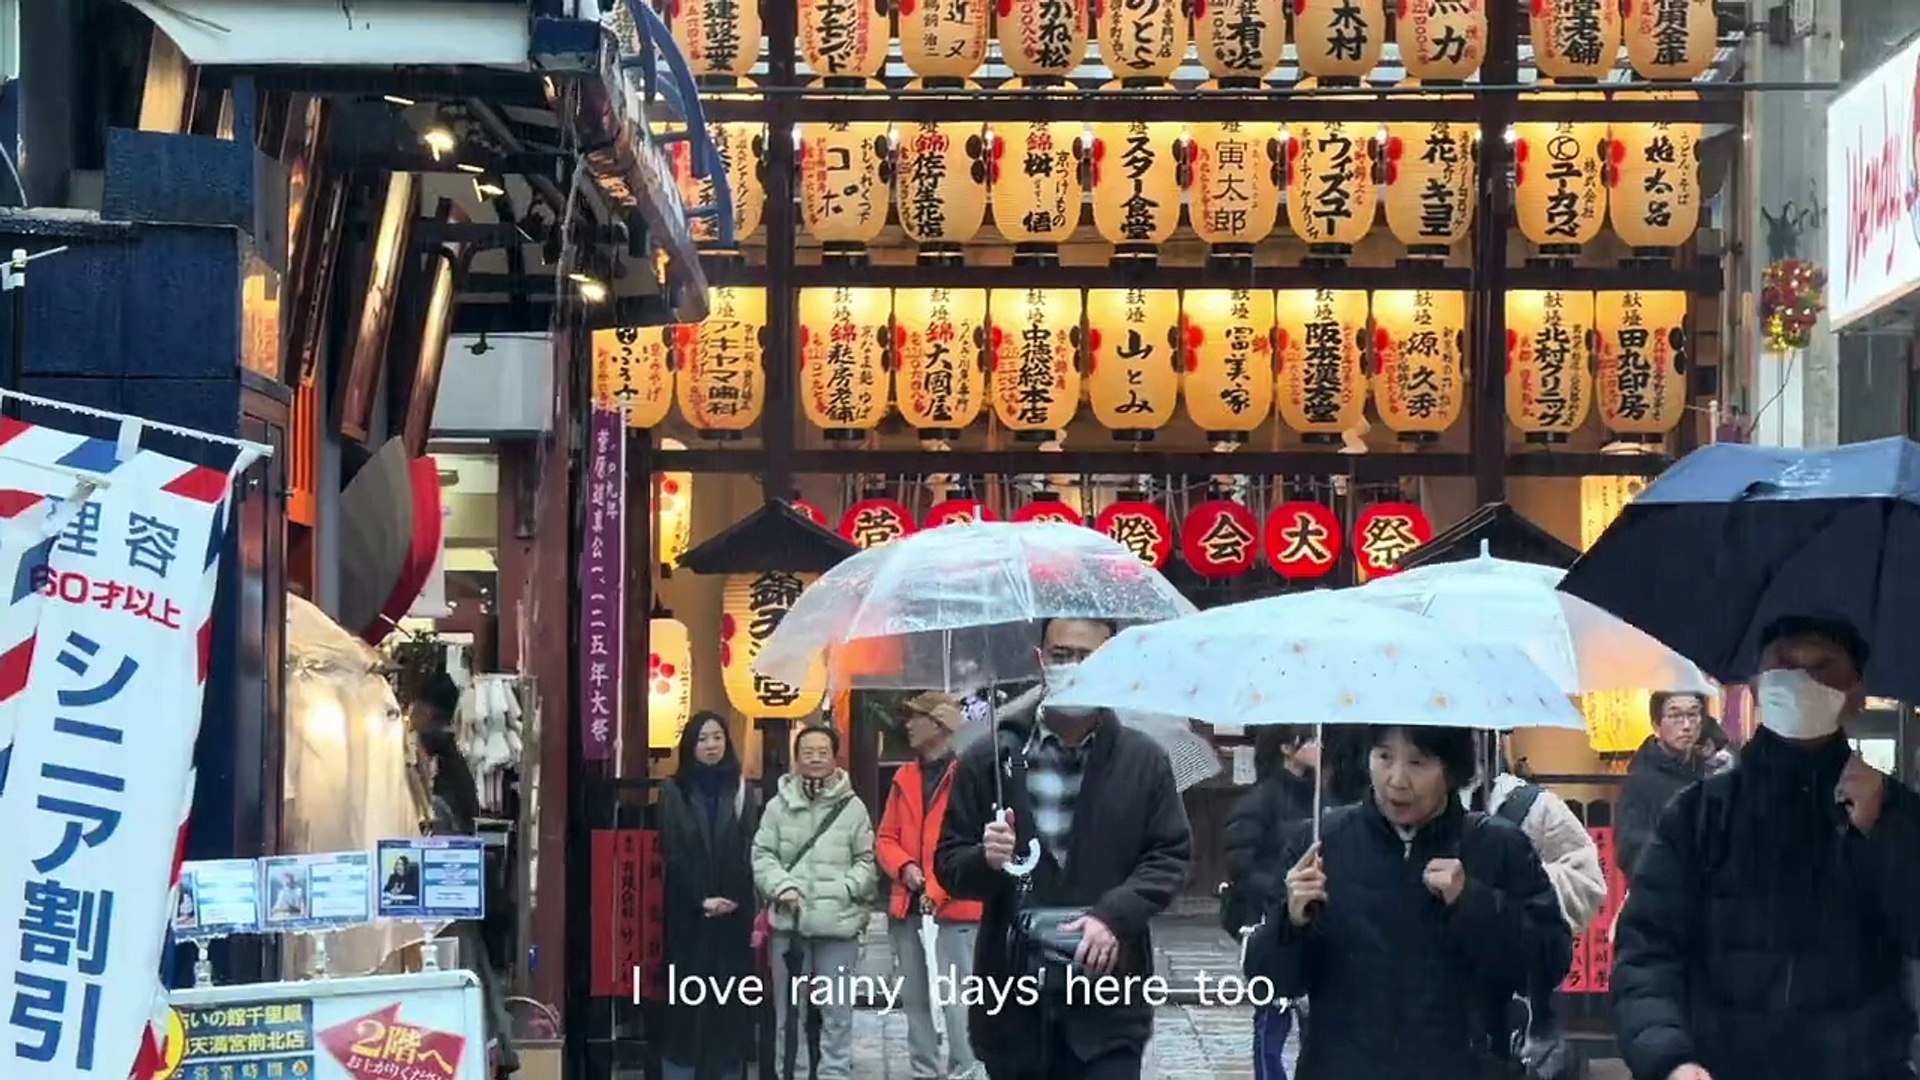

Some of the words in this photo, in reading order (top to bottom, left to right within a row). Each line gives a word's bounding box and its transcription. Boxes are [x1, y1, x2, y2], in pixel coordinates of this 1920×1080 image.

[1035, 0, 1073, 68] かね松
[1326, 1, 1369, 61] 木村
[1120, 135, 1160, 239] スター食堂
[1213, 138, 1249, 236] 寅太郎
[1313, 133, 1354, 236] ウィズユー
[1114, 329, 1155, 414] 山とみ
[1534, 326, 1571, 426] 北村クリニック
[1617, 328, 1651, 421] 田丸印房
[32, 563, 183, 630] 60才以上
[9, 630, 140, 1071] シニア割引
[184, 1031, 306, 1056] 天満宮前北店
[351, 1018, 453, 1075] 2階へ
